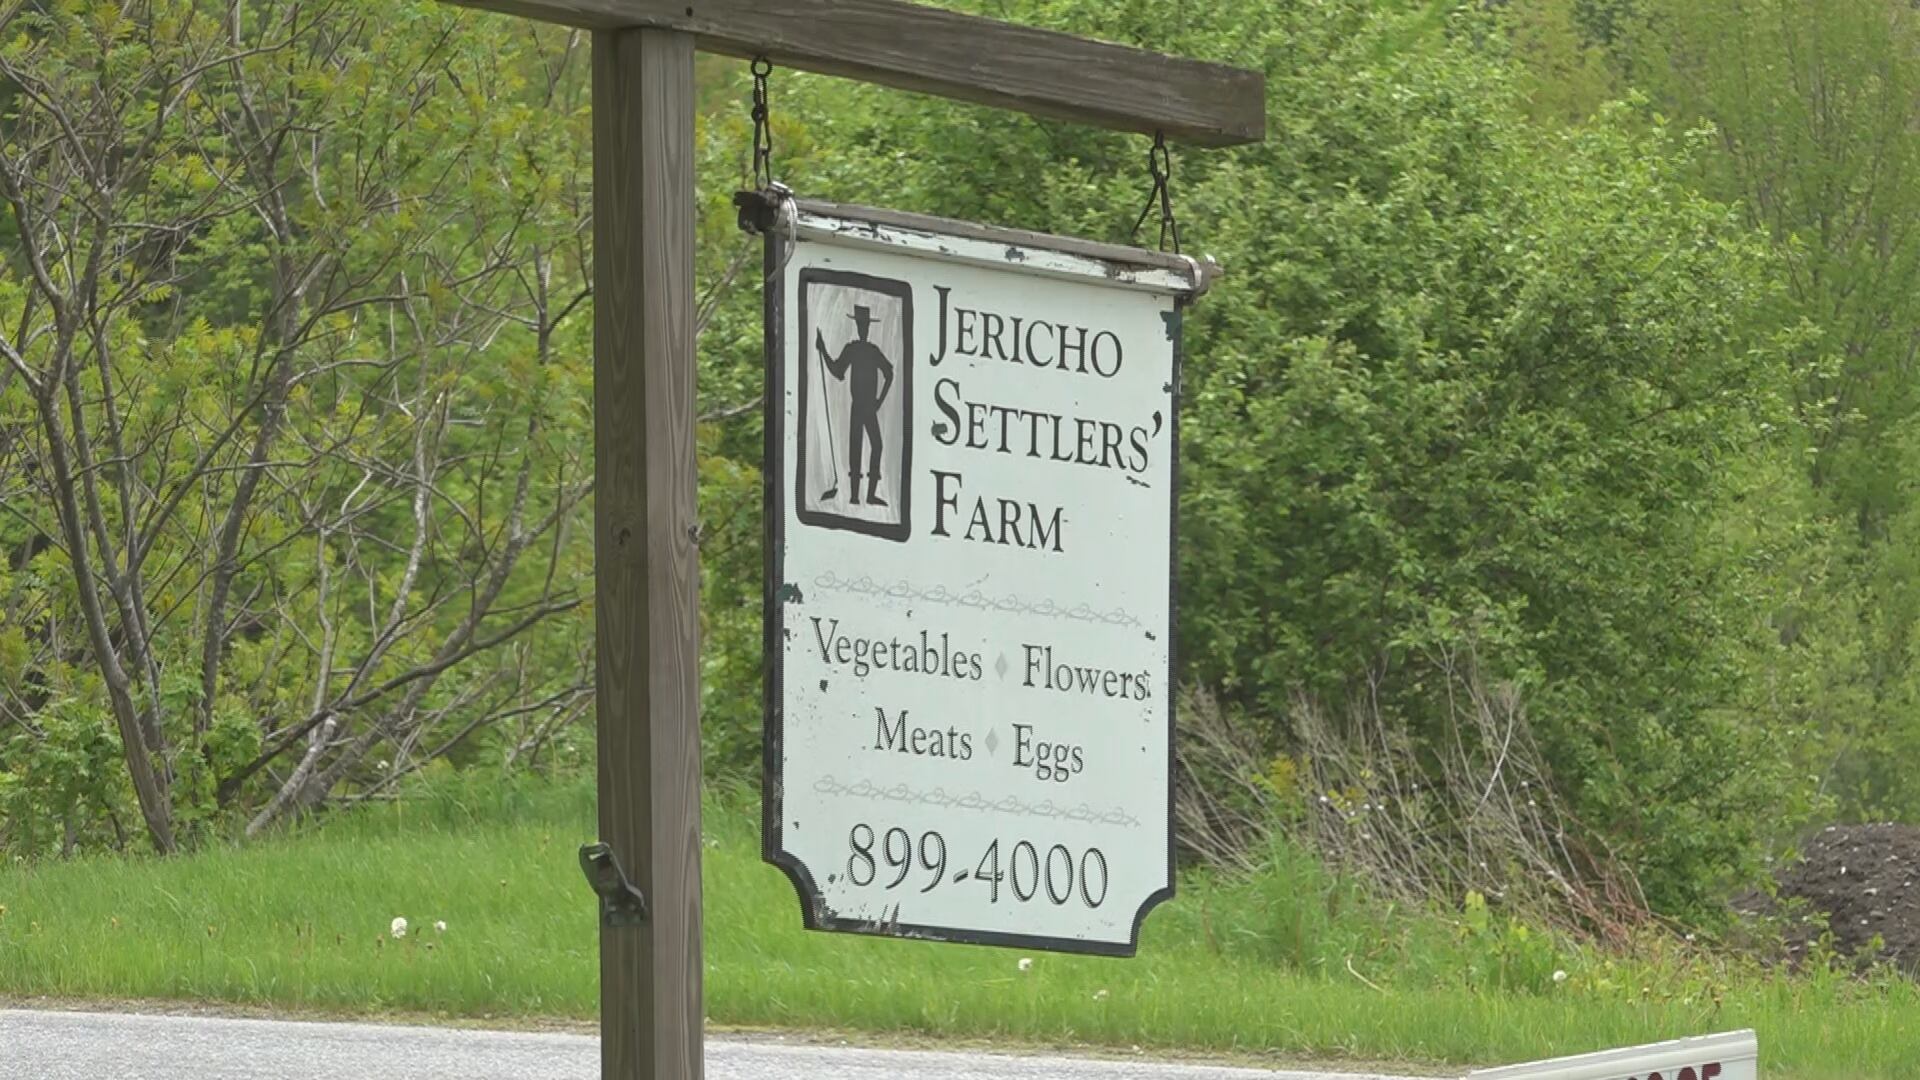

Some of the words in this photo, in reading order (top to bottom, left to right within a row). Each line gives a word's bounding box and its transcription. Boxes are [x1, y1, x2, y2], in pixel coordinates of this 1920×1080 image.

[930, 285, 1123, 378] JERICHO
[930, 469, 1065, 553] FARM
[810, 616, 983, 681] Vegetables
[1022, 643, 1146, 701] Flowers
[874, 706, 973, 760] Meats
[1012, 723, 1084, 782] Eggs
[846, 823, 1108, 908] 899-4000
